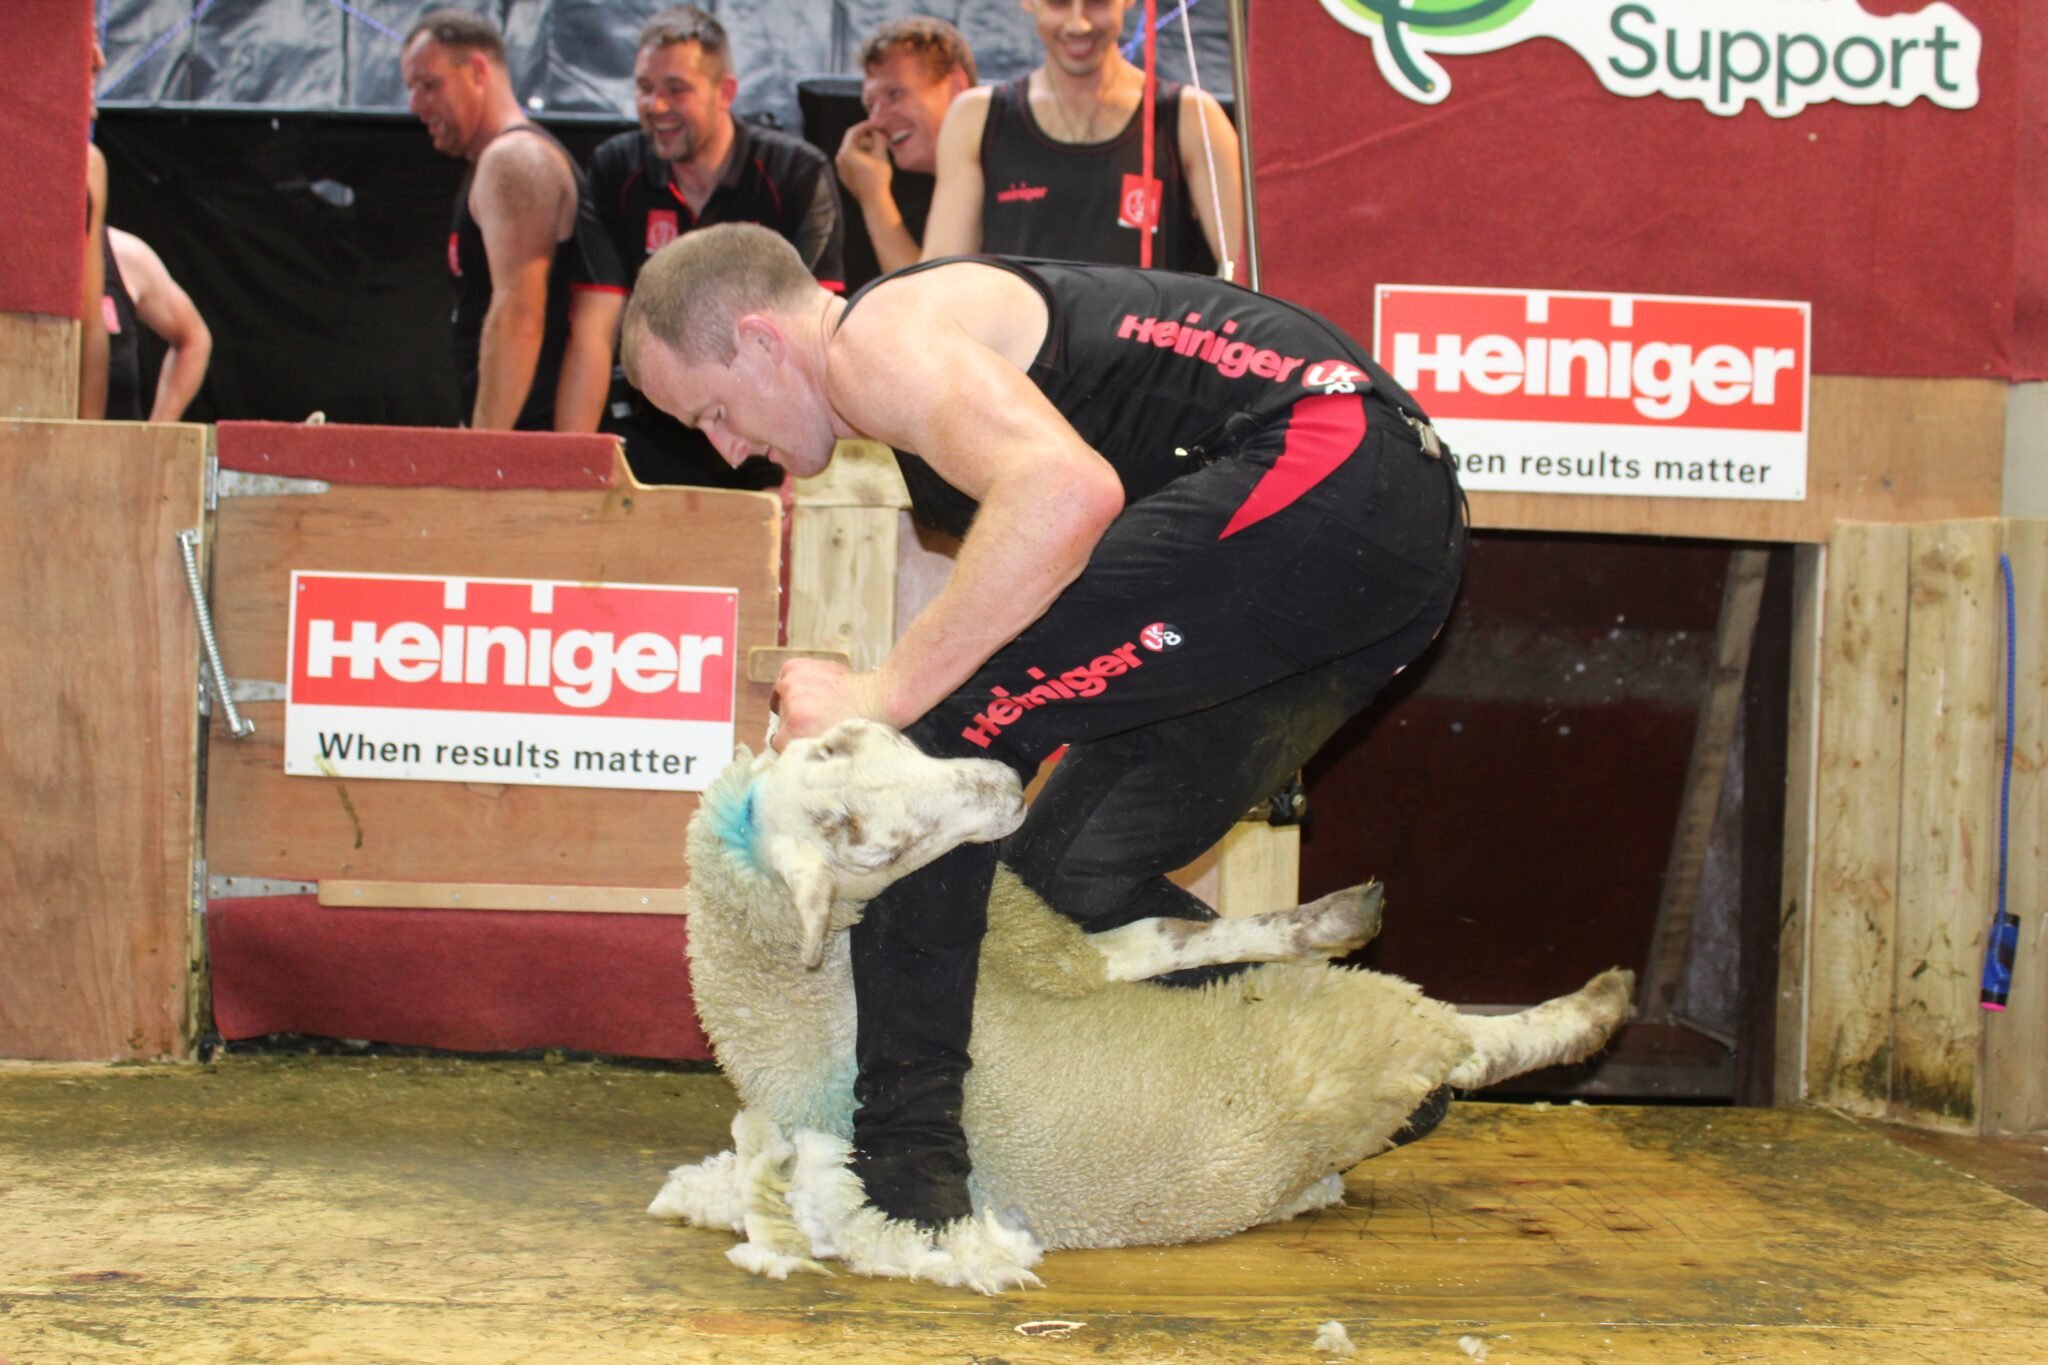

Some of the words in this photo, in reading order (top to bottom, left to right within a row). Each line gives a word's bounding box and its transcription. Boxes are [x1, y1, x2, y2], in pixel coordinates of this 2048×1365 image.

[1608, 3, 1960, 106] Support
[1117, 312, 1305, 383] Heiniger
[1394, 294, 1795, 419] Heiniger
[1453, 453, 1505, 473] en
[1520, 451, 1640, 479] results
[1654, 459, 1771, 484] matter
[307, 581, 724, 708] Heiniger
[961, 642, 1143, 749] Heiniger
[318, 732, 421, 763] When
[436, 740, 560, 769] results
[574, 749, 698, 775] matter
